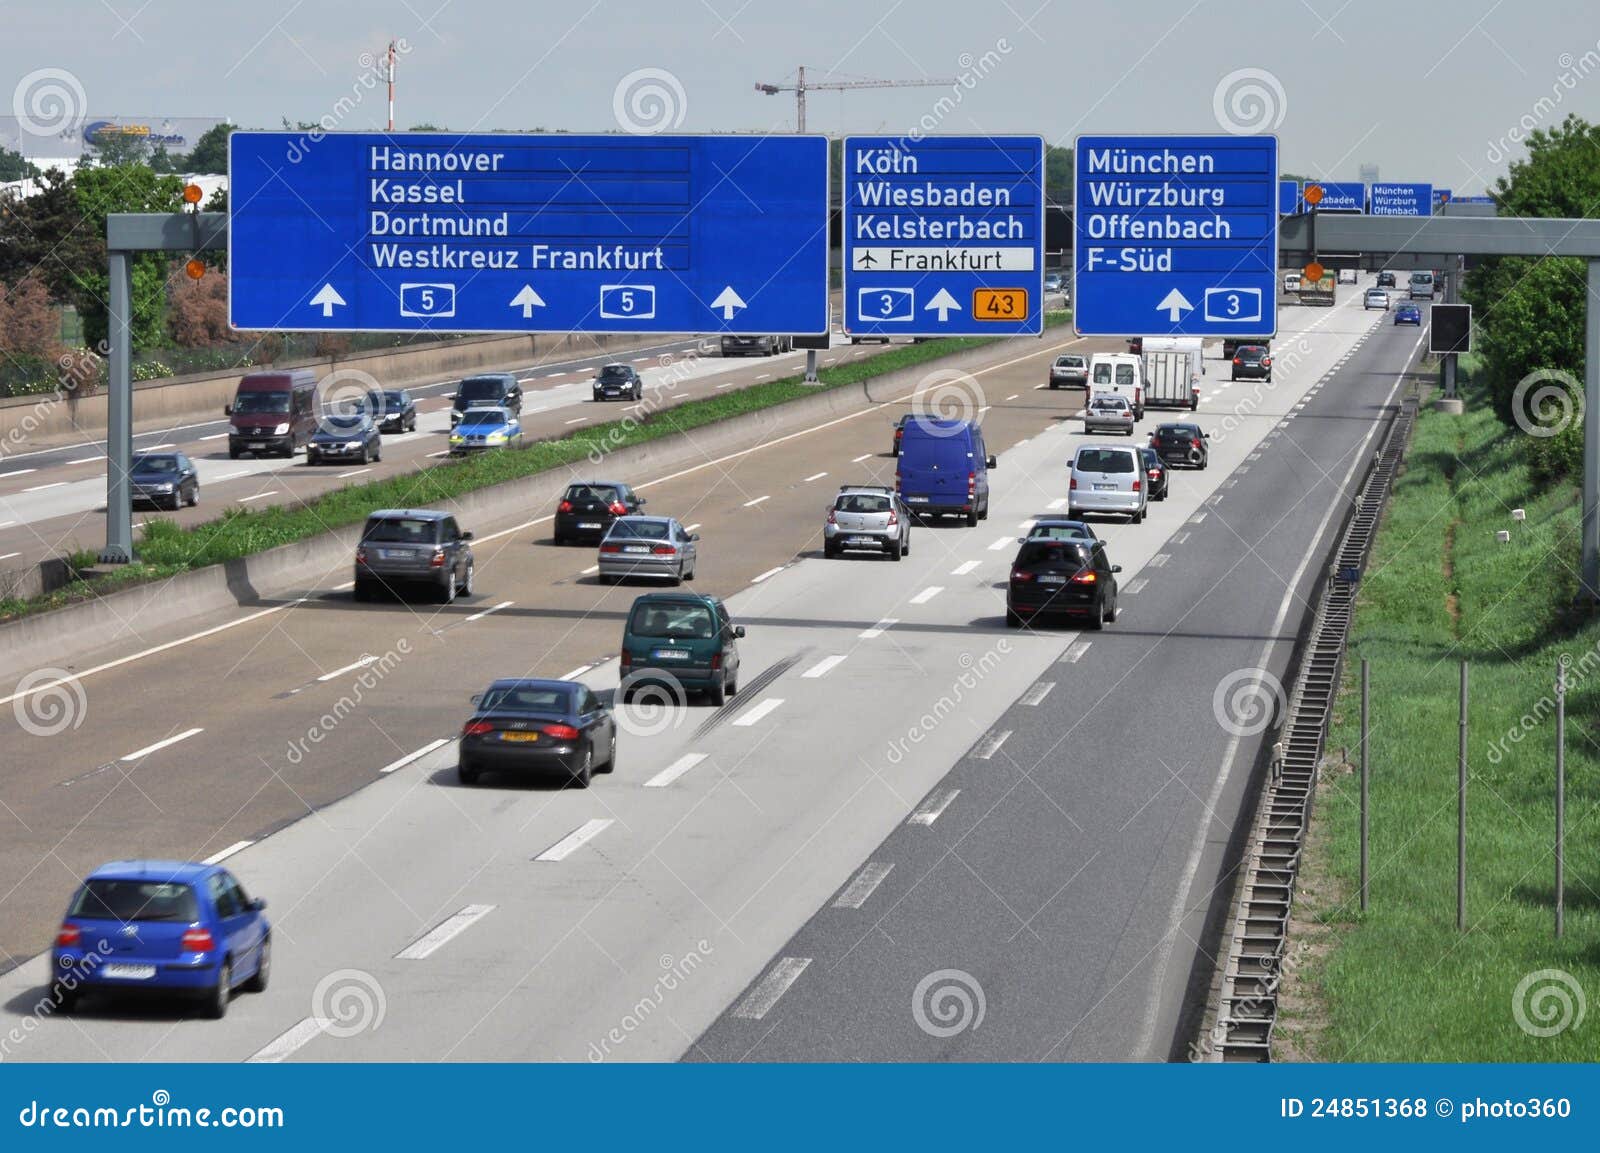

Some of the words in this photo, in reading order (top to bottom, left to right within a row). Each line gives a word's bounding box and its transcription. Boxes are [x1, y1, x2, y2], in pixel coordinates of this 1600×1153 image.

[372, 147, 503, 170] Hannover
[857, 149, 917, 173] Köln
[1089, 149, 1214, 172] München
[372, 179, 464, 202] Kassel
[858, 182, 1009, 206] Wiesbaden
[1090, 182, 1224, 206] Würzburg
[1374, 186, 1414, 195] München
[1375, 196, 1417, 205] Würzburg
[1374, 206, 1419, 215] Offenbach
[372, 212, 507, 235] Dortmund
[858, 215, 1023, 238] Kelsterbach
[1089, 215, 1230, 238] Offenbach
[373, 244, 518, 268] Westkreuz
[532, 245, 663, 269] Frankfurt
[889, 250, 1003, 271] Frankfurt
[1089, 248, 1171, 271] F-Süd
[421, 290, 434, 311] 5
[621, 291, 634, 312] 5
[880, 294, 893, 315] 3
[987, 294, 1014, 315] 43
[1227, 294, 1240, 315] 3
